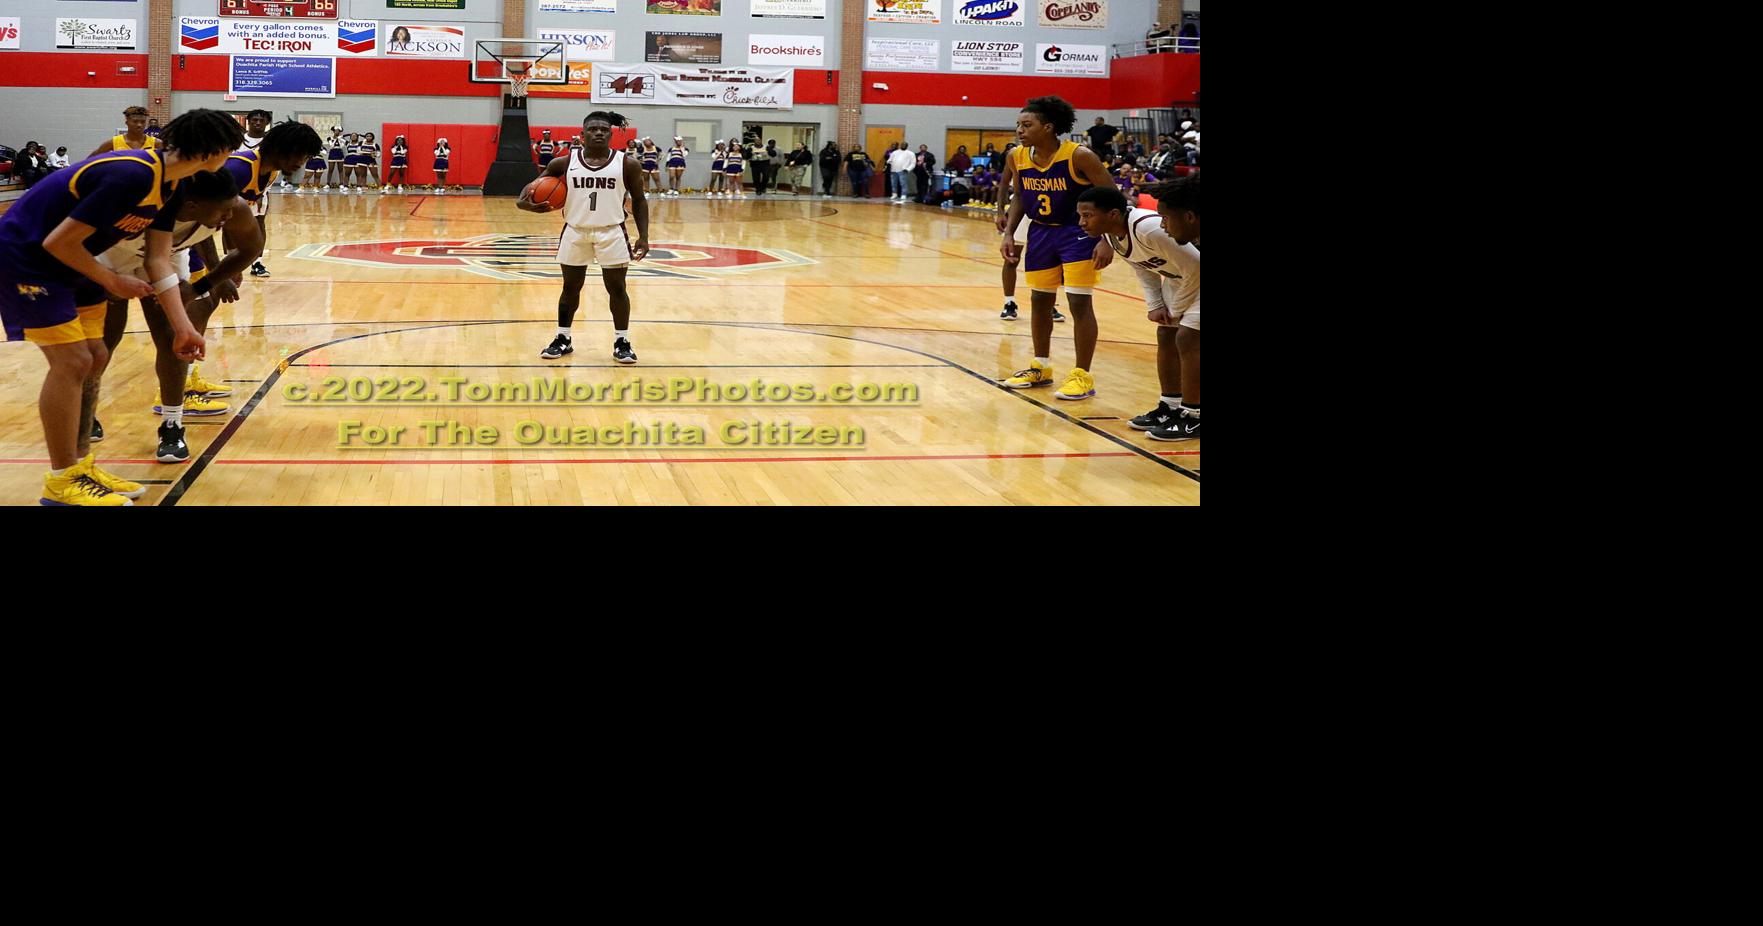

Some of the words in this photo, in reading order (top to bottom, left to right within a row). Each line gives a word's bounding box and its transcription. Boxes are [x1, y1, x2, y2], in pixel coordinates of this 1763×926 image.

[285, 6, 293, 16] 4
[87, 24, 131, 40] Swartz
[233, 23, 260, 31] Every
[263, 23, 291, 32] gallon
[390, 41, 461, 52] JACKSON
[751, 45, 822, 56] Brookshire's
[1044, 46, 1099, 62] GORMAN
[610, 76, 644, 93] 44
[572, 177, 616, 189] LIONS
[1022, 177, 1067, 191] WOSSMAN
[588, 192, 597, 211] 1
[1038, 194, 1051, 216] 3
